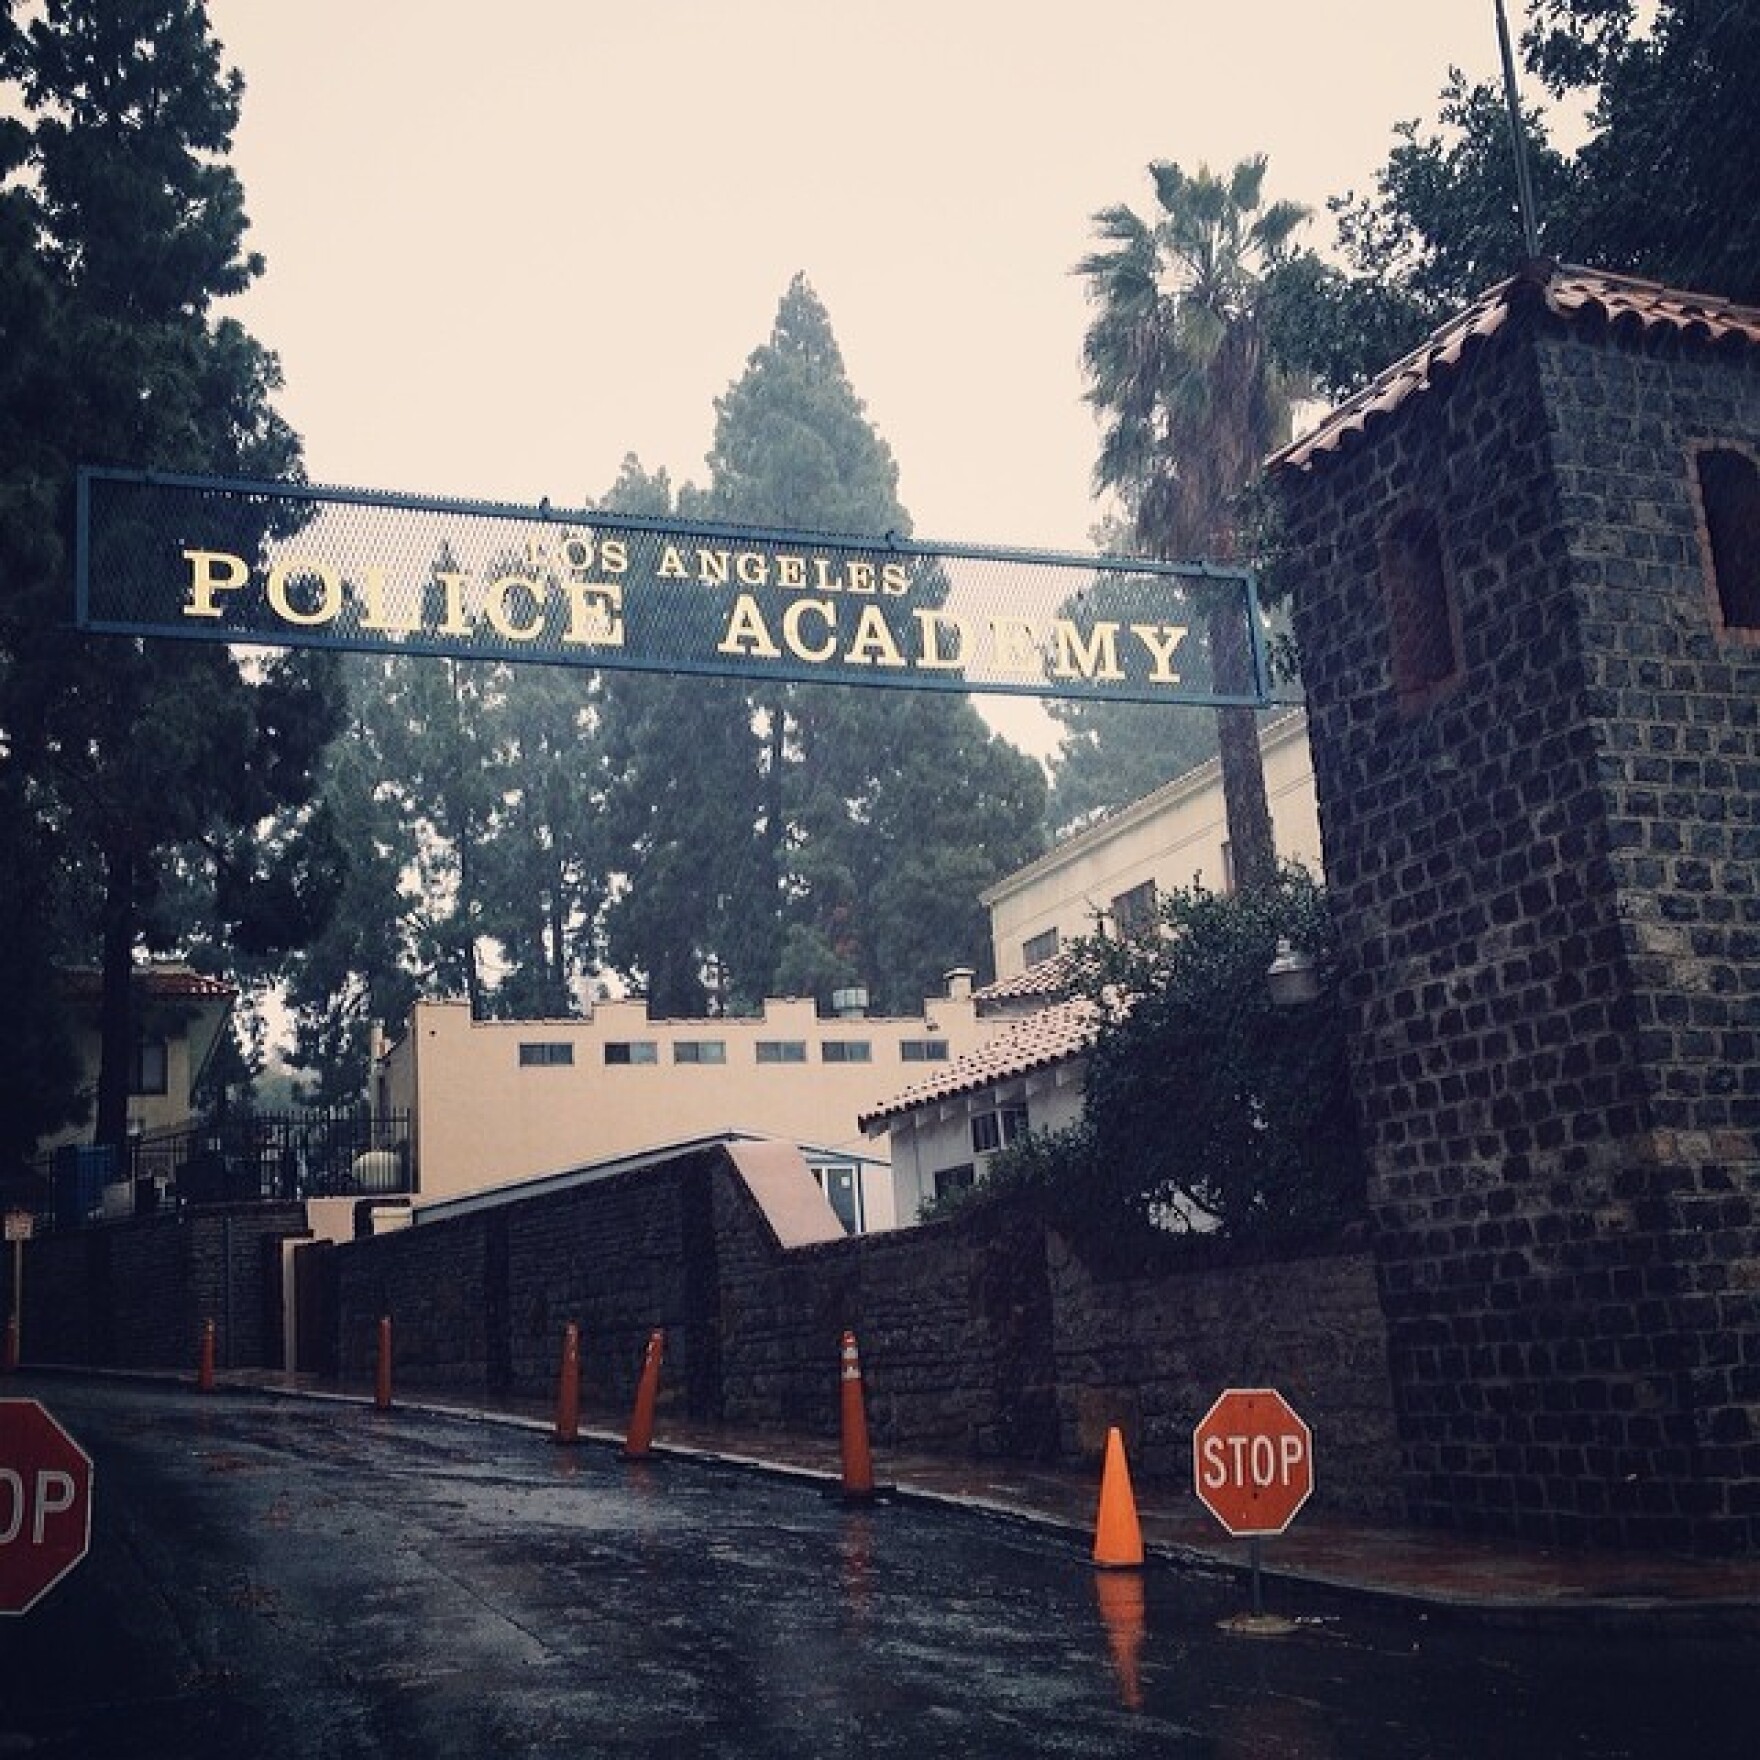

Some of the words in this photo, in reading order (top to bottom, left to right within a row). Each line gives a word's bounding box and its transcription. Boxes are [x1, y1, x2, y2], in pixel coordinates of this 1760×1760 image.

[527, 534, 628, 573] LOS
[657, 547, 910, 594] ANGELES
[183, 549, 625, 646] POLICE
[718, 595, 1189, 682] ACADEMY
[1204, 1435, 1303, 1488] STOP
